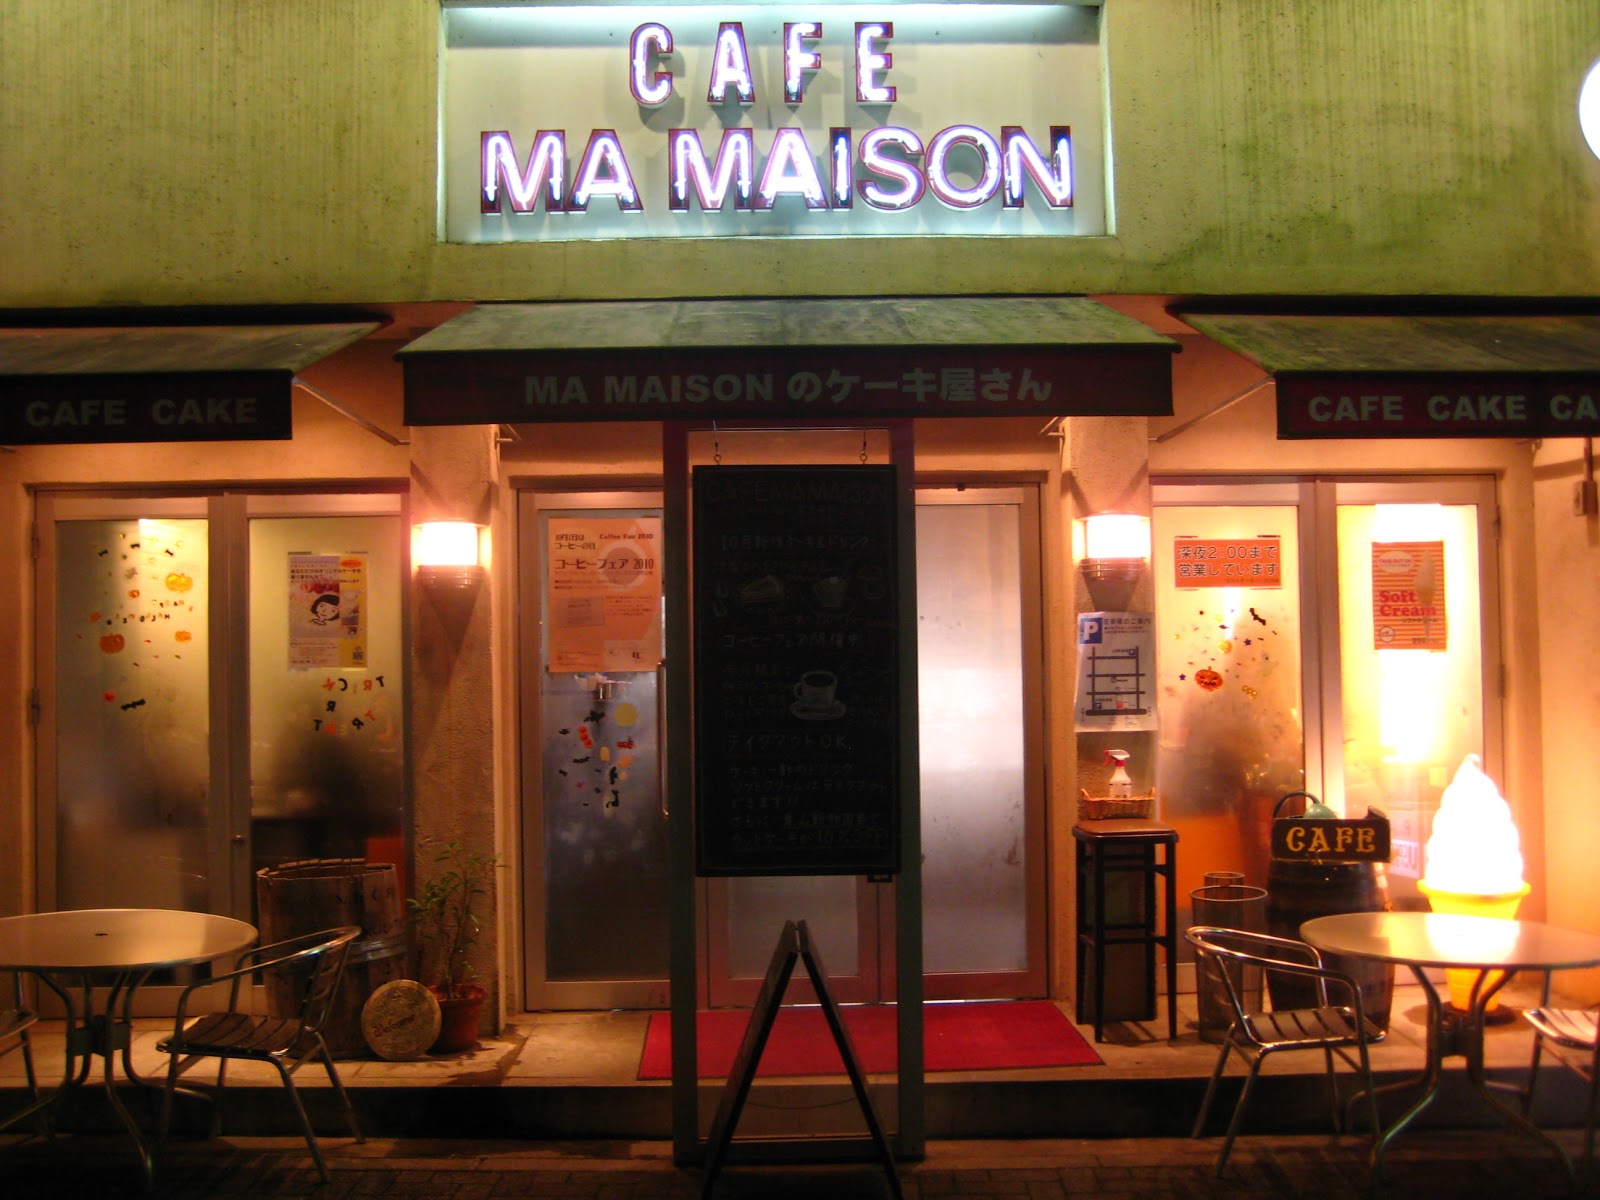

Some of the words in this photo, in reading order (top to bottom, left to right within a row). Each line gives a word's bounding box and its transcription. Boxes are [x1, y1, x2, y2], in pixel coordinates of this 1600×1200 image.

[629, 21, 897, 106] CAFE
[480, 129, 644, 214] MA
[668, 125, 1075, 213] MAISON
[524, 375, 589, 406] MA
[604, 373, 774, 405] MAISON
[788, 367, 1052, 403] のケーキ屋さん
[25, 399, 128, 427] CAFE
[152, 398, 257, 425] CAKE
[1308, 395, 1404, 422] CAFE
[1427, 395, 1528, 421] CAKE
[555, 542, 596, 550] コーヒーの日
[1178, 546, 1277, 560] 深夜2:00まで
[555, 559, 629, 569] コーヒーフェア
[633, 559, 654, 569] 2010
[1178, 563, 1277, 577] 営業しています
[1379, 590, 1416, 603] Soft
[1380, 604, 1437, 617] Cream
[1083, 621, 1099, 640] P
[1286, 827, 1376, 852] CAFE
